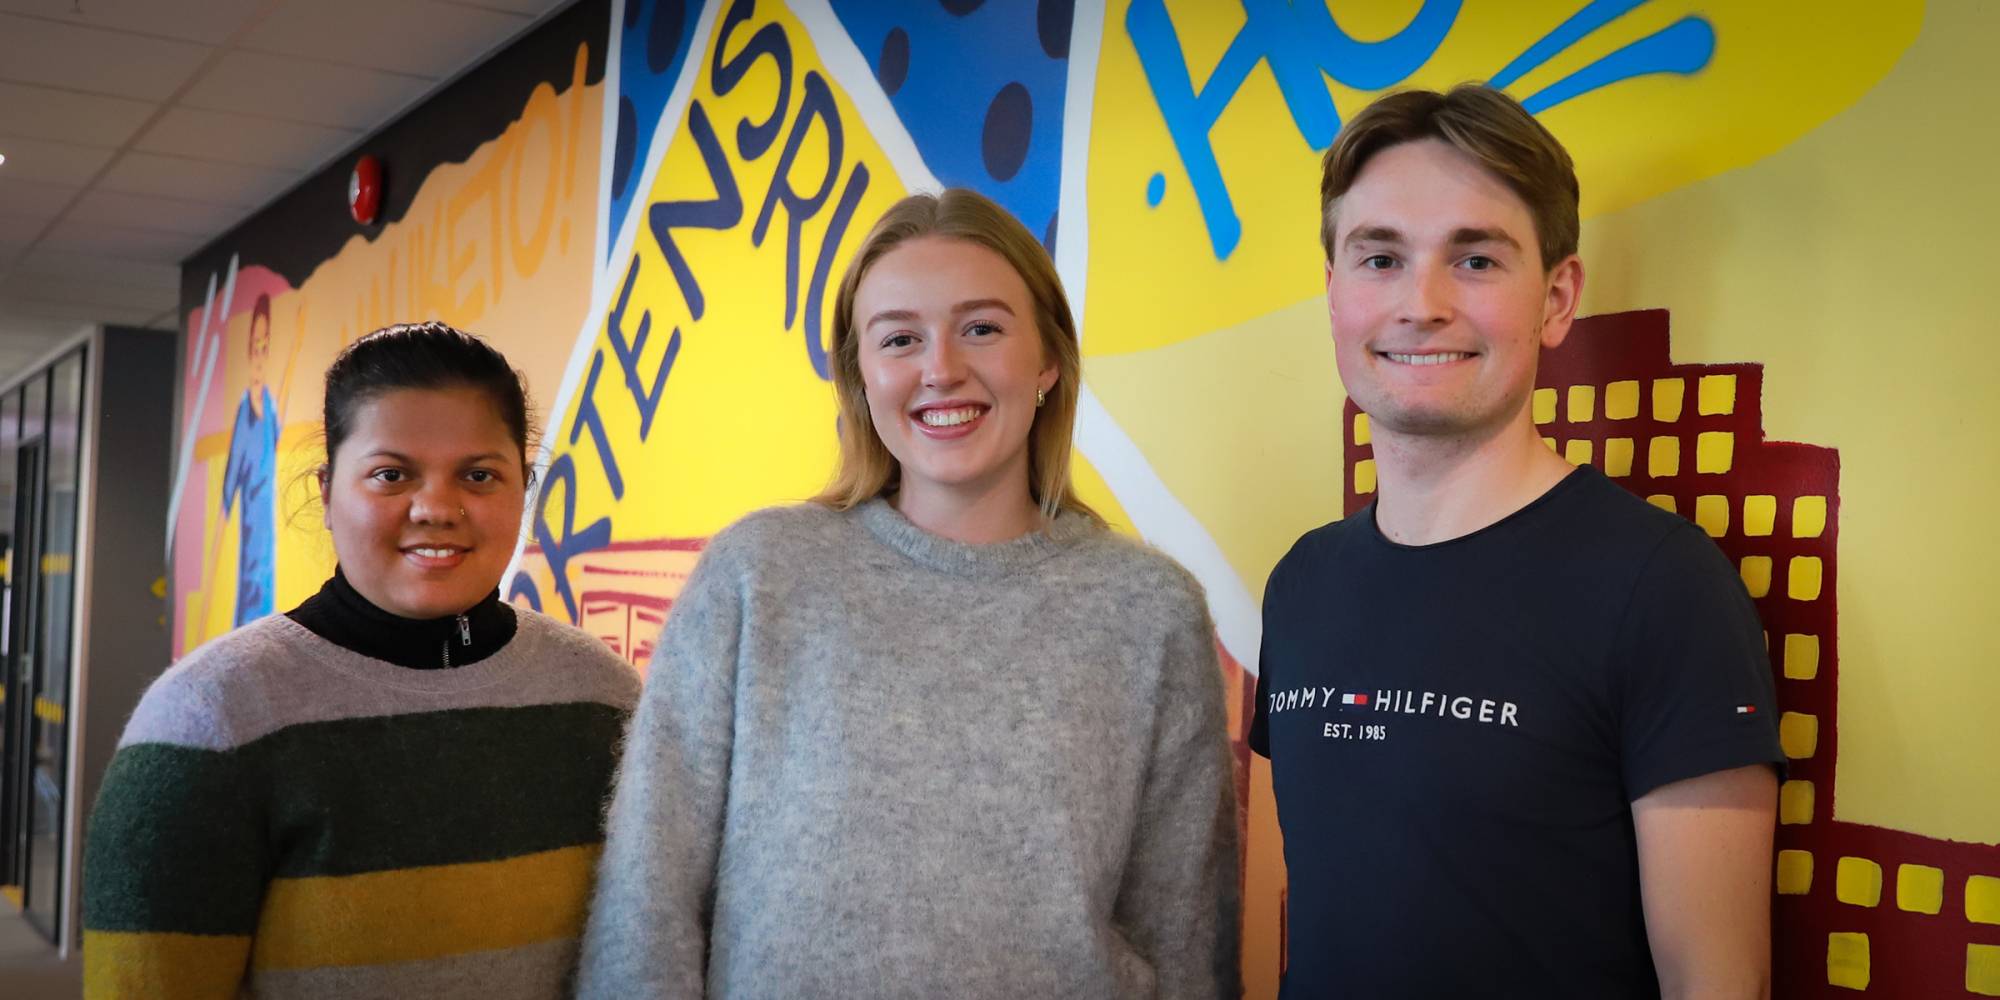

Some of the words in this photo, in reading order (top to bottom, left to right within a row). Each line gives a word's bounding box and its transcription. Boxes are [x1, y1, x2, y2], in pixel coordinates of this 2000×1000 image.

[1269, 686, 1336, 714] TOMMY
[1375, 689, 1519, 727] HILFIGER
[1323, 722, 1352, 739] EST.
[1359, 725, 1386, 740] 1985
